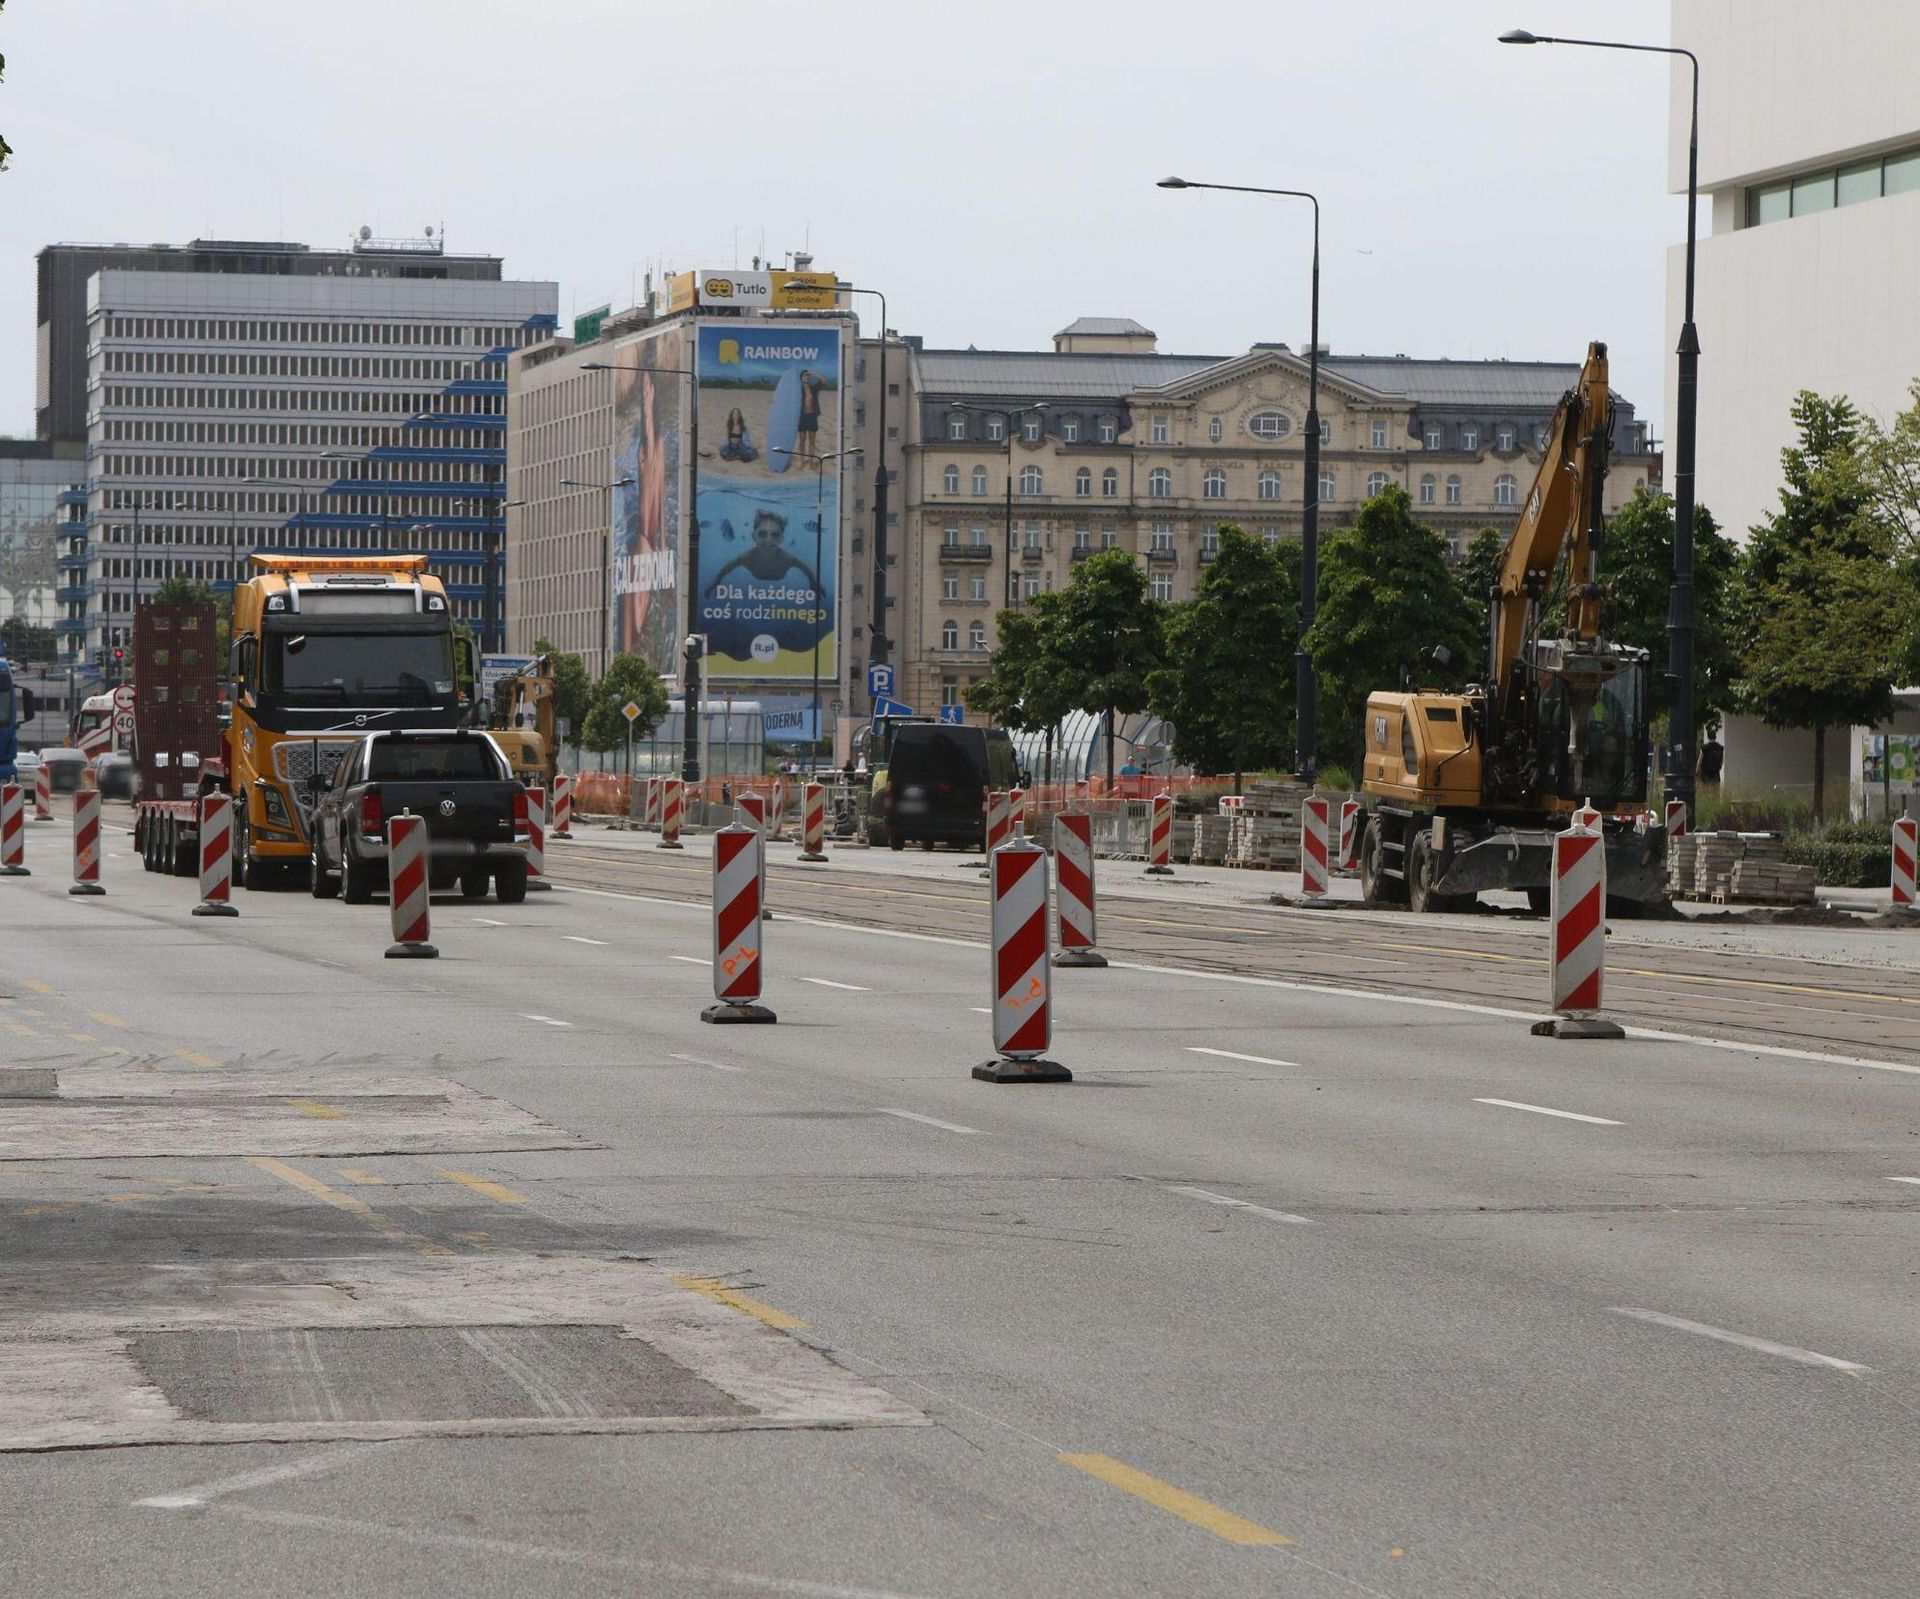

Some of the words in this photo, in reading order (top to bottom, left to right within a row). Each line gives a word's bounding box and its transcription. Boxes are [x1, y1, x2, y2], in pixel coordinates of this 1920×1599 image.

[736, 283, 767, 295] Tutlo
[744, 346, 819, 360] RAINBOW
[717, 584, 743, 600] Dla
[748, 584, 816, 604] każdego
[704, 603, 732, 619] coś
[736, 604, 827, 625] rodzinnego
[117, 717, 135, 729] 40
[765, 711, 804, 731] ODERNĄ
